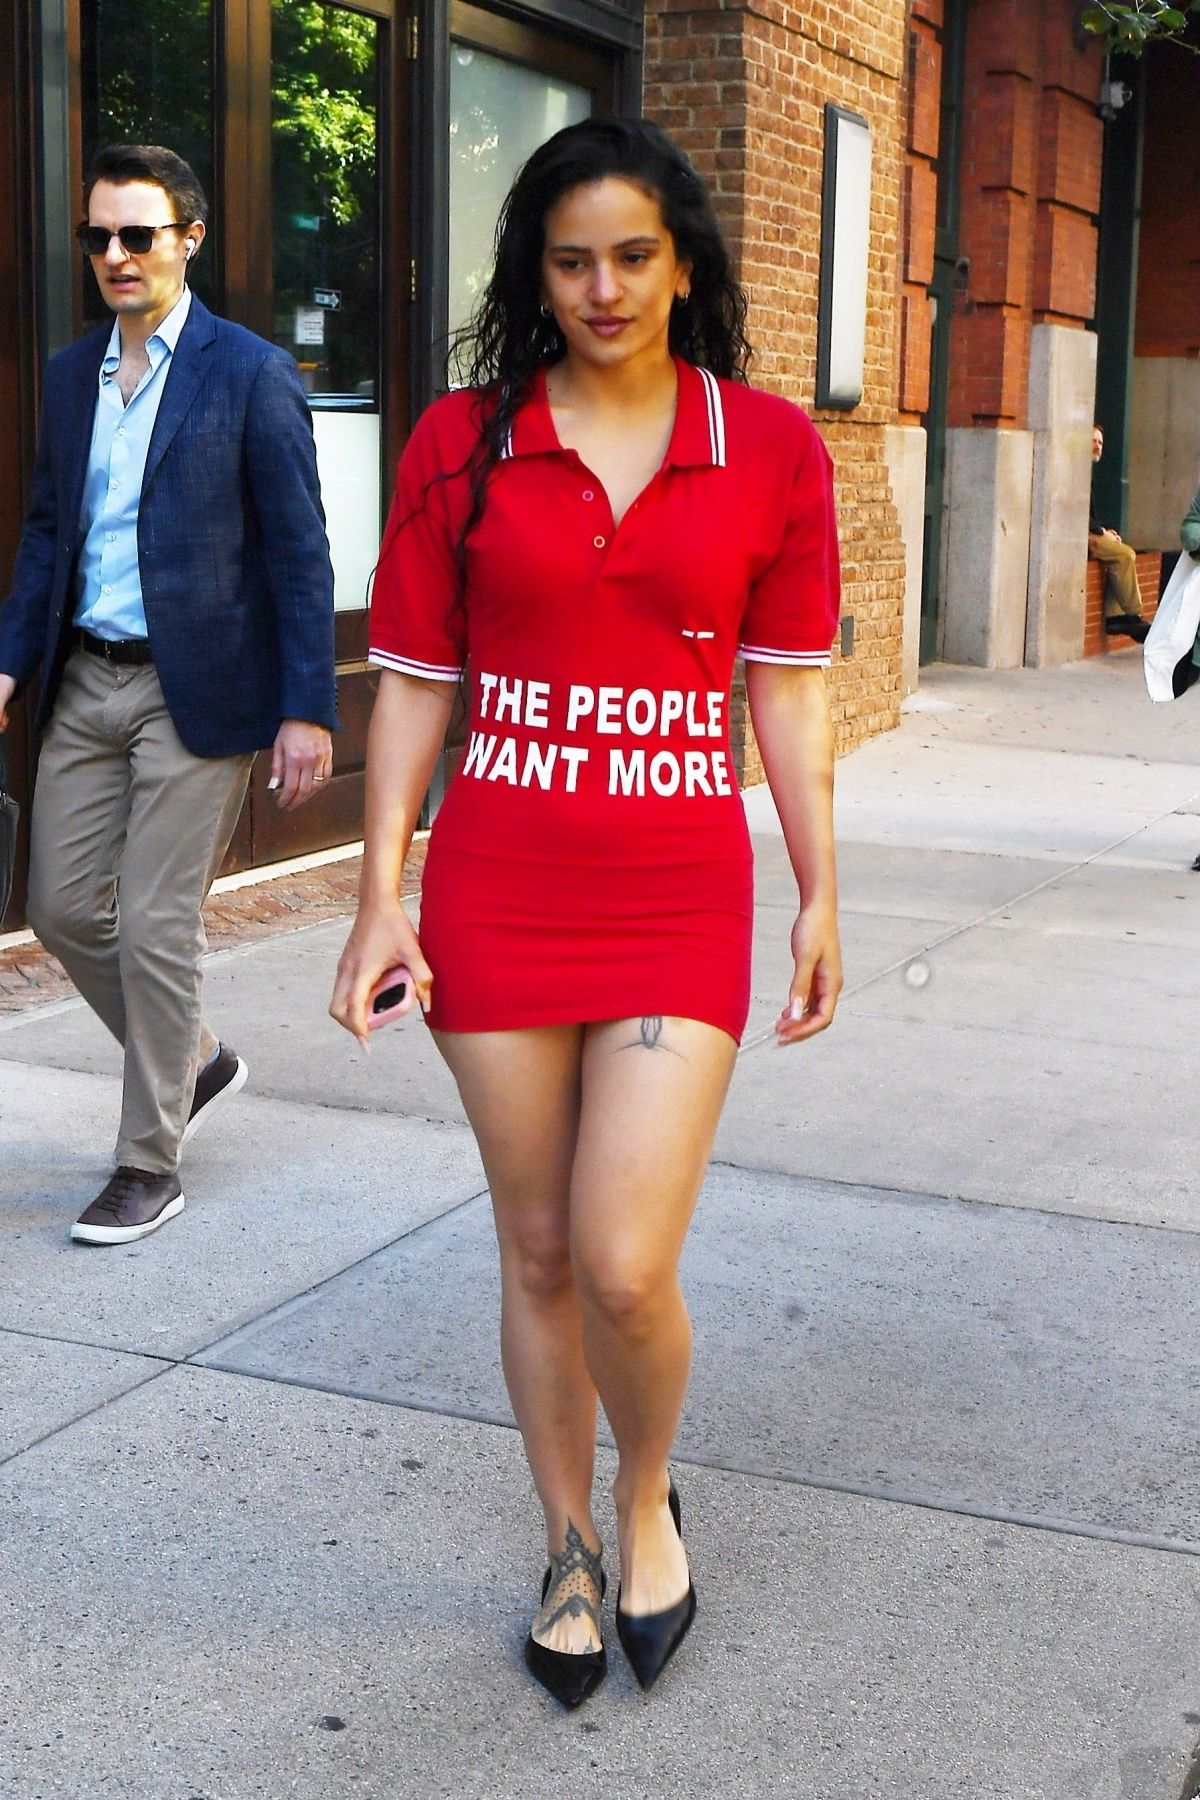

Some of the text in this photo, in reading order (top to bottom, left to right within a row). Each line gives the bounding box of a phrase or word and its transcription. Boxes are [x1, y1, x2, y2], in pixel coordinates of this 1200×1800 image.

[480, 672, 725, 737] THE PEOPLE
[462, 731, 732, 797] WANT MORE
